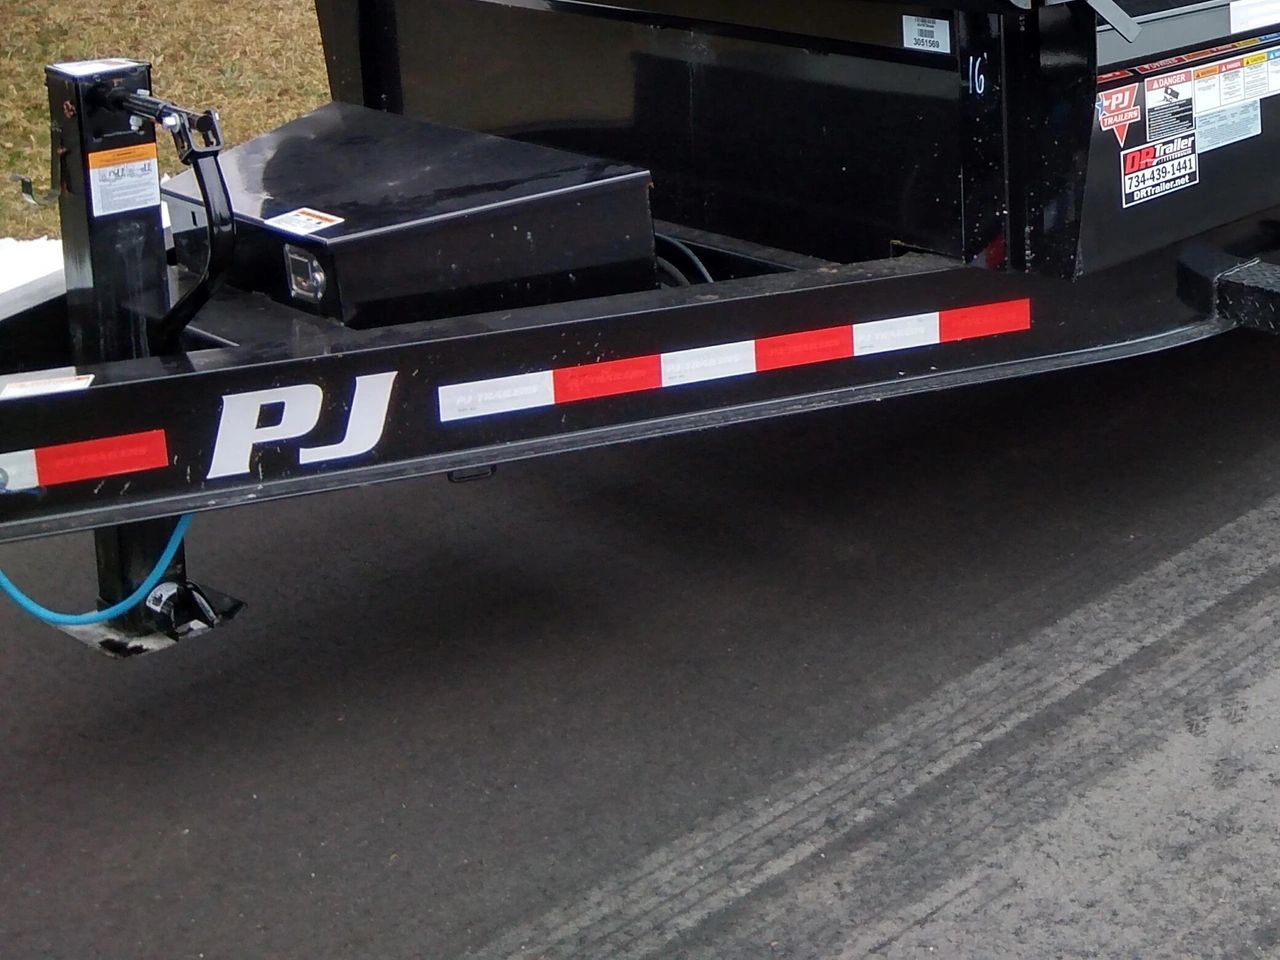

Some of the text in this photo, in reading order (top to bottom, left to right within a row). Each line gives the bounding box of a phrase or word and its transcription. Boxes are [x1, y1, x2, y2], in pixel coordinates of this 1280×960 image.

[913, 37, 940, 49] 3051569
[1159, 73, 1186, 88] DANGER
[1110, 91, 1131, 111] PJ
[1102, 110, 1138, 127] TRAILERS
[1127, 157, 1193, 190] 734-439-1441
[1133, 174, 1190, 201] DRTrailer.net
[206, 371, 398, 479] PJ
